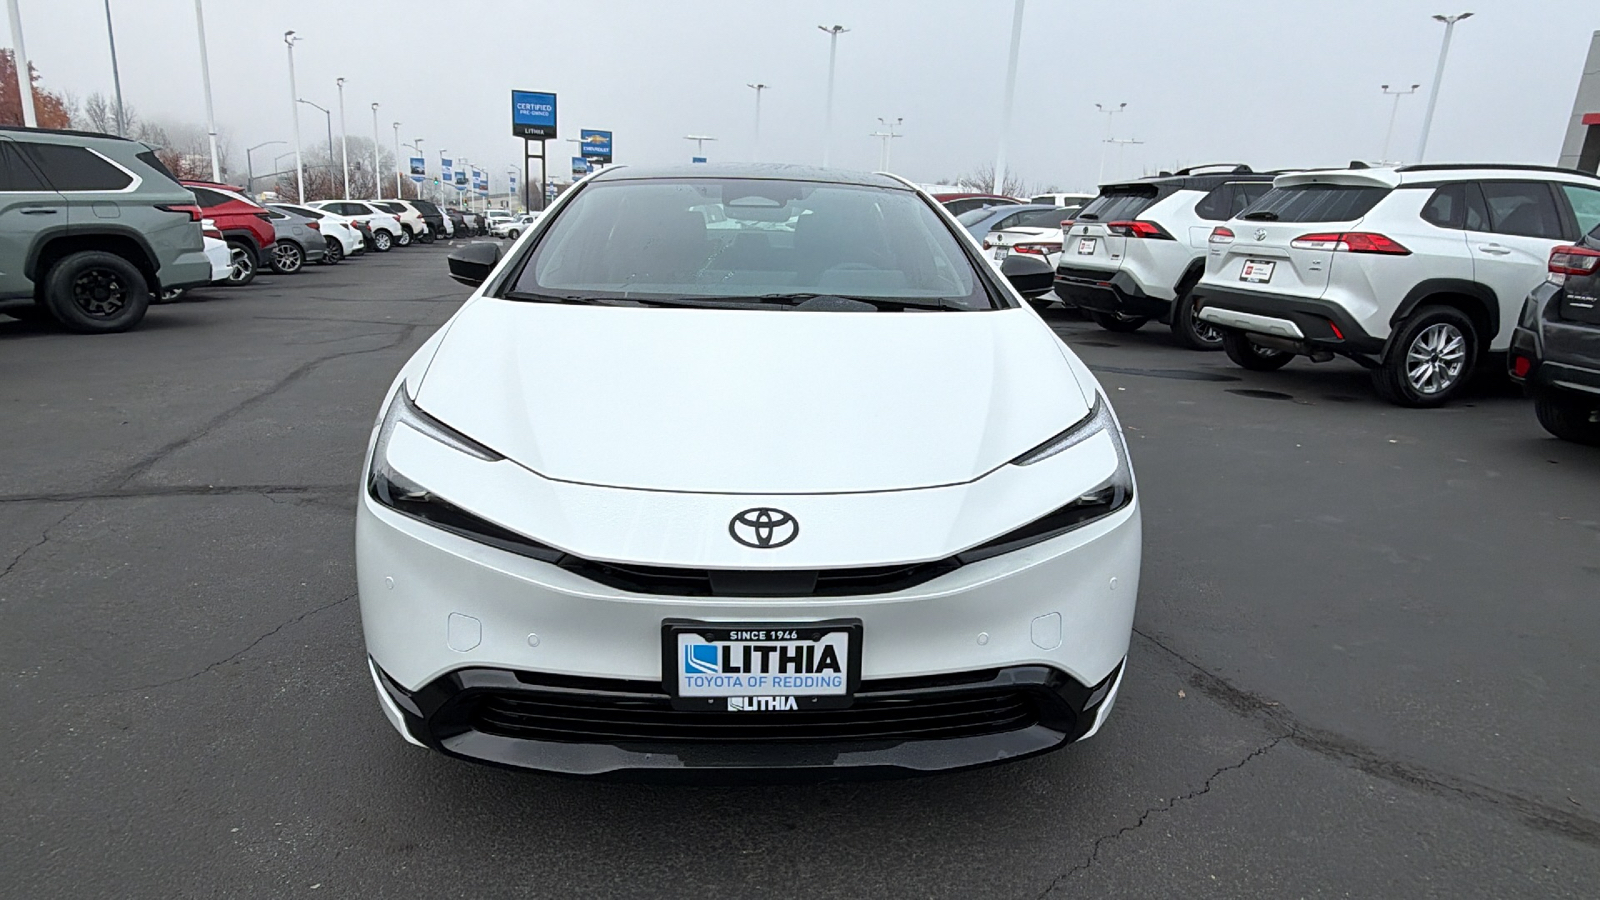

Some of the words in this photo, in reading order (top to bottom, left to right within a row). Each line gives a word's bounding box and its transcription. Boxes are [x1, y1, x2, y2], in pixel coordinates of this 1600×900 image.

[517, 103, 552, 111] CERTIFIED
[730, 631, 766, 640] SINCE
[770, 631, 797, 639] 1946
[722, 645, 841, 673] LITHIA
[685, 676, 743, 688] TOYOTA
[747, 676, 767, 687] OF
[772, 676, 842, 688] REDDING
[744, 696, 798, 711] LITHIA
